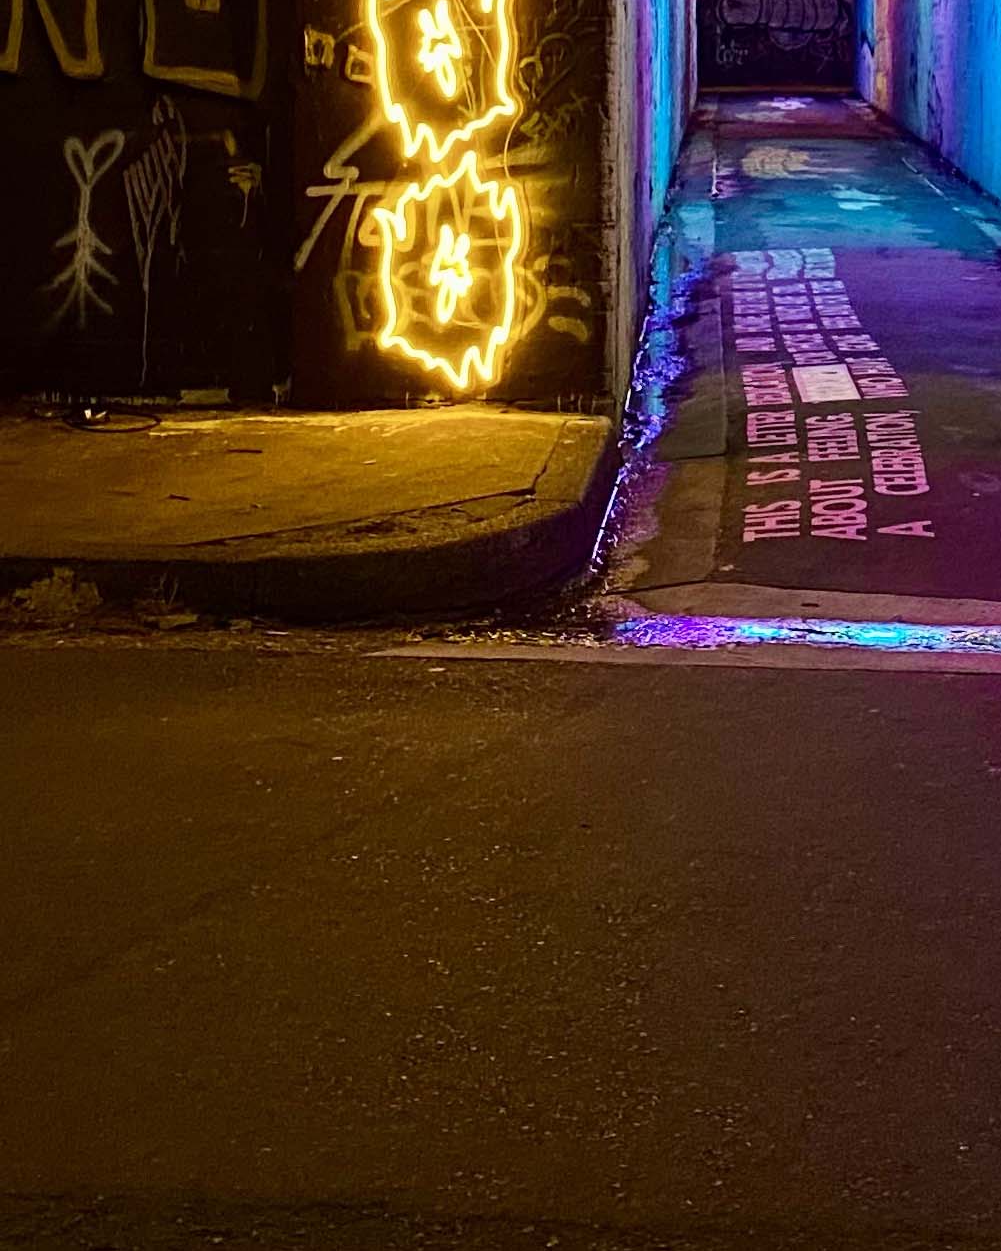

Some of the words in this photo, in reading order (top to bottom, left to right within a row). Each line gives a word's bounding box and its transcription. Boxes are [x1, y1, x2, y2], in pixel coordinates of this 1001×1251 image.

[844, 357, 897, 376] HAVE
[857, 376, 910, 399] WHO
[746, 410, 799, 448] LETTER
[747, 451, 800, 463] A
[746, 468, 802, 486] IS
[809, 478, 868, 541] ABOUT
[742, 500, 802, 542] THIS
[876, 520, 935, 538] A
